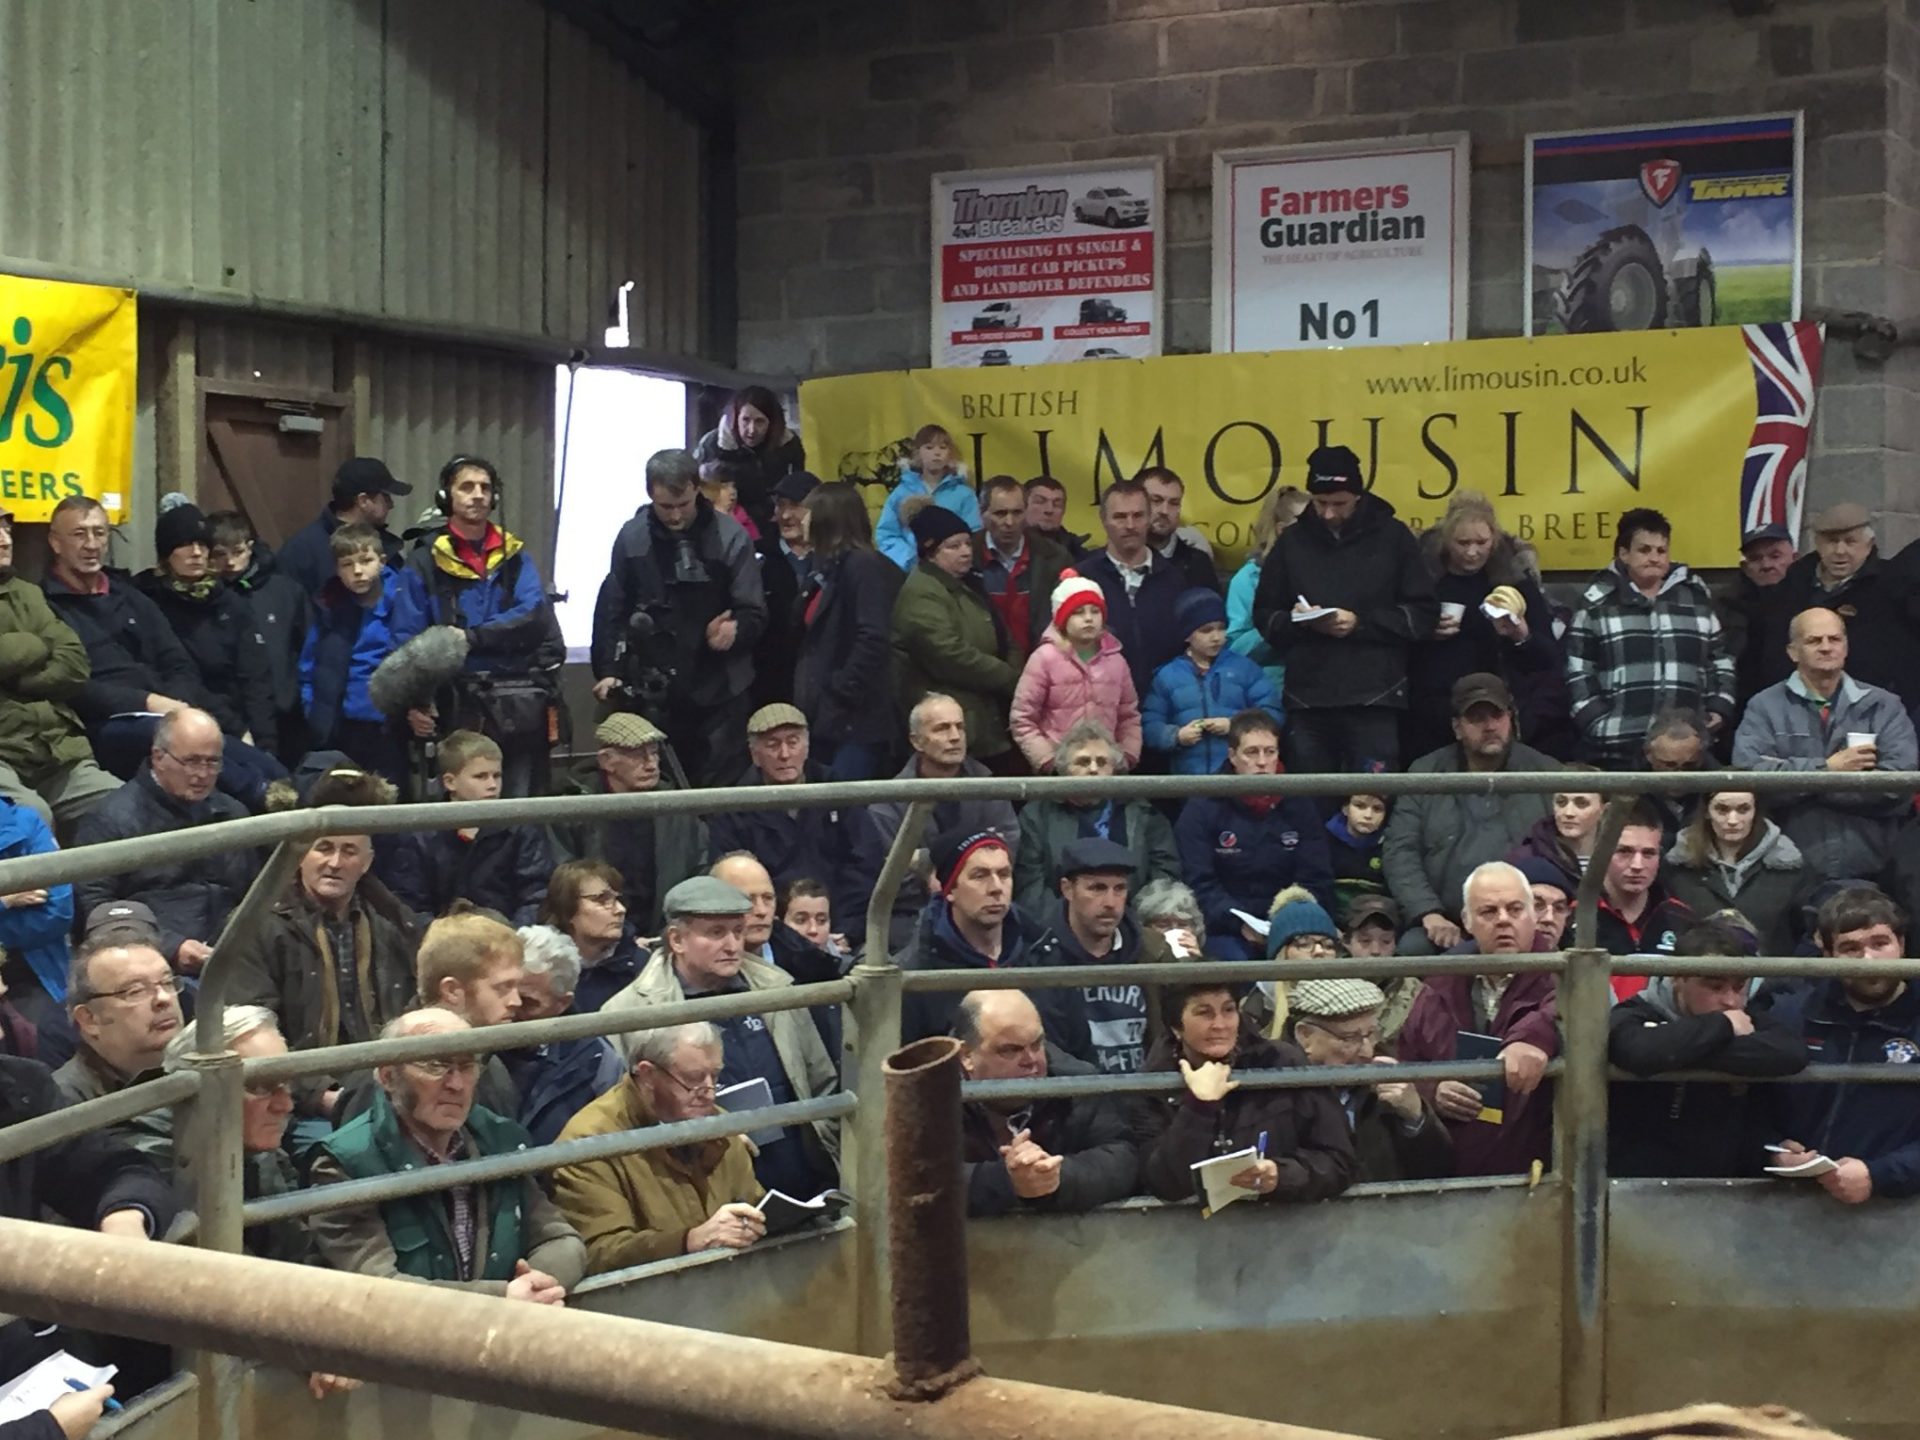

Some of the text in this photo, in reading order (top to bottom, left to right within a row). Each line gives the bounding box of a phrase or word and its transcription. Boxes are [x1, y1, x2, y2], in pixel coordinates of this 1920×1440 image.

[1260, 184, 1410, 218] Farmers
[978, 215, 1065, 238] Breakers
[1260, 211, 1426, 249] Guardian
[958, 239, 1142, 263] SPECIALISING IN SINGLE &
[1262, 254, 1283, 265] THE
[1286, 252, 1323, 264] HEART
[974, 257, 1128, 279] DOUBLE CAB PICKUPS
[951, 273, 1152, 297] AND LANDROVER DEFENDERS
[1365, 356, 1648, 395] www.limousin.co.uk
[961, 390, 1080, 420] BRITISH
[1518, 511, 1617, 541] BREE
